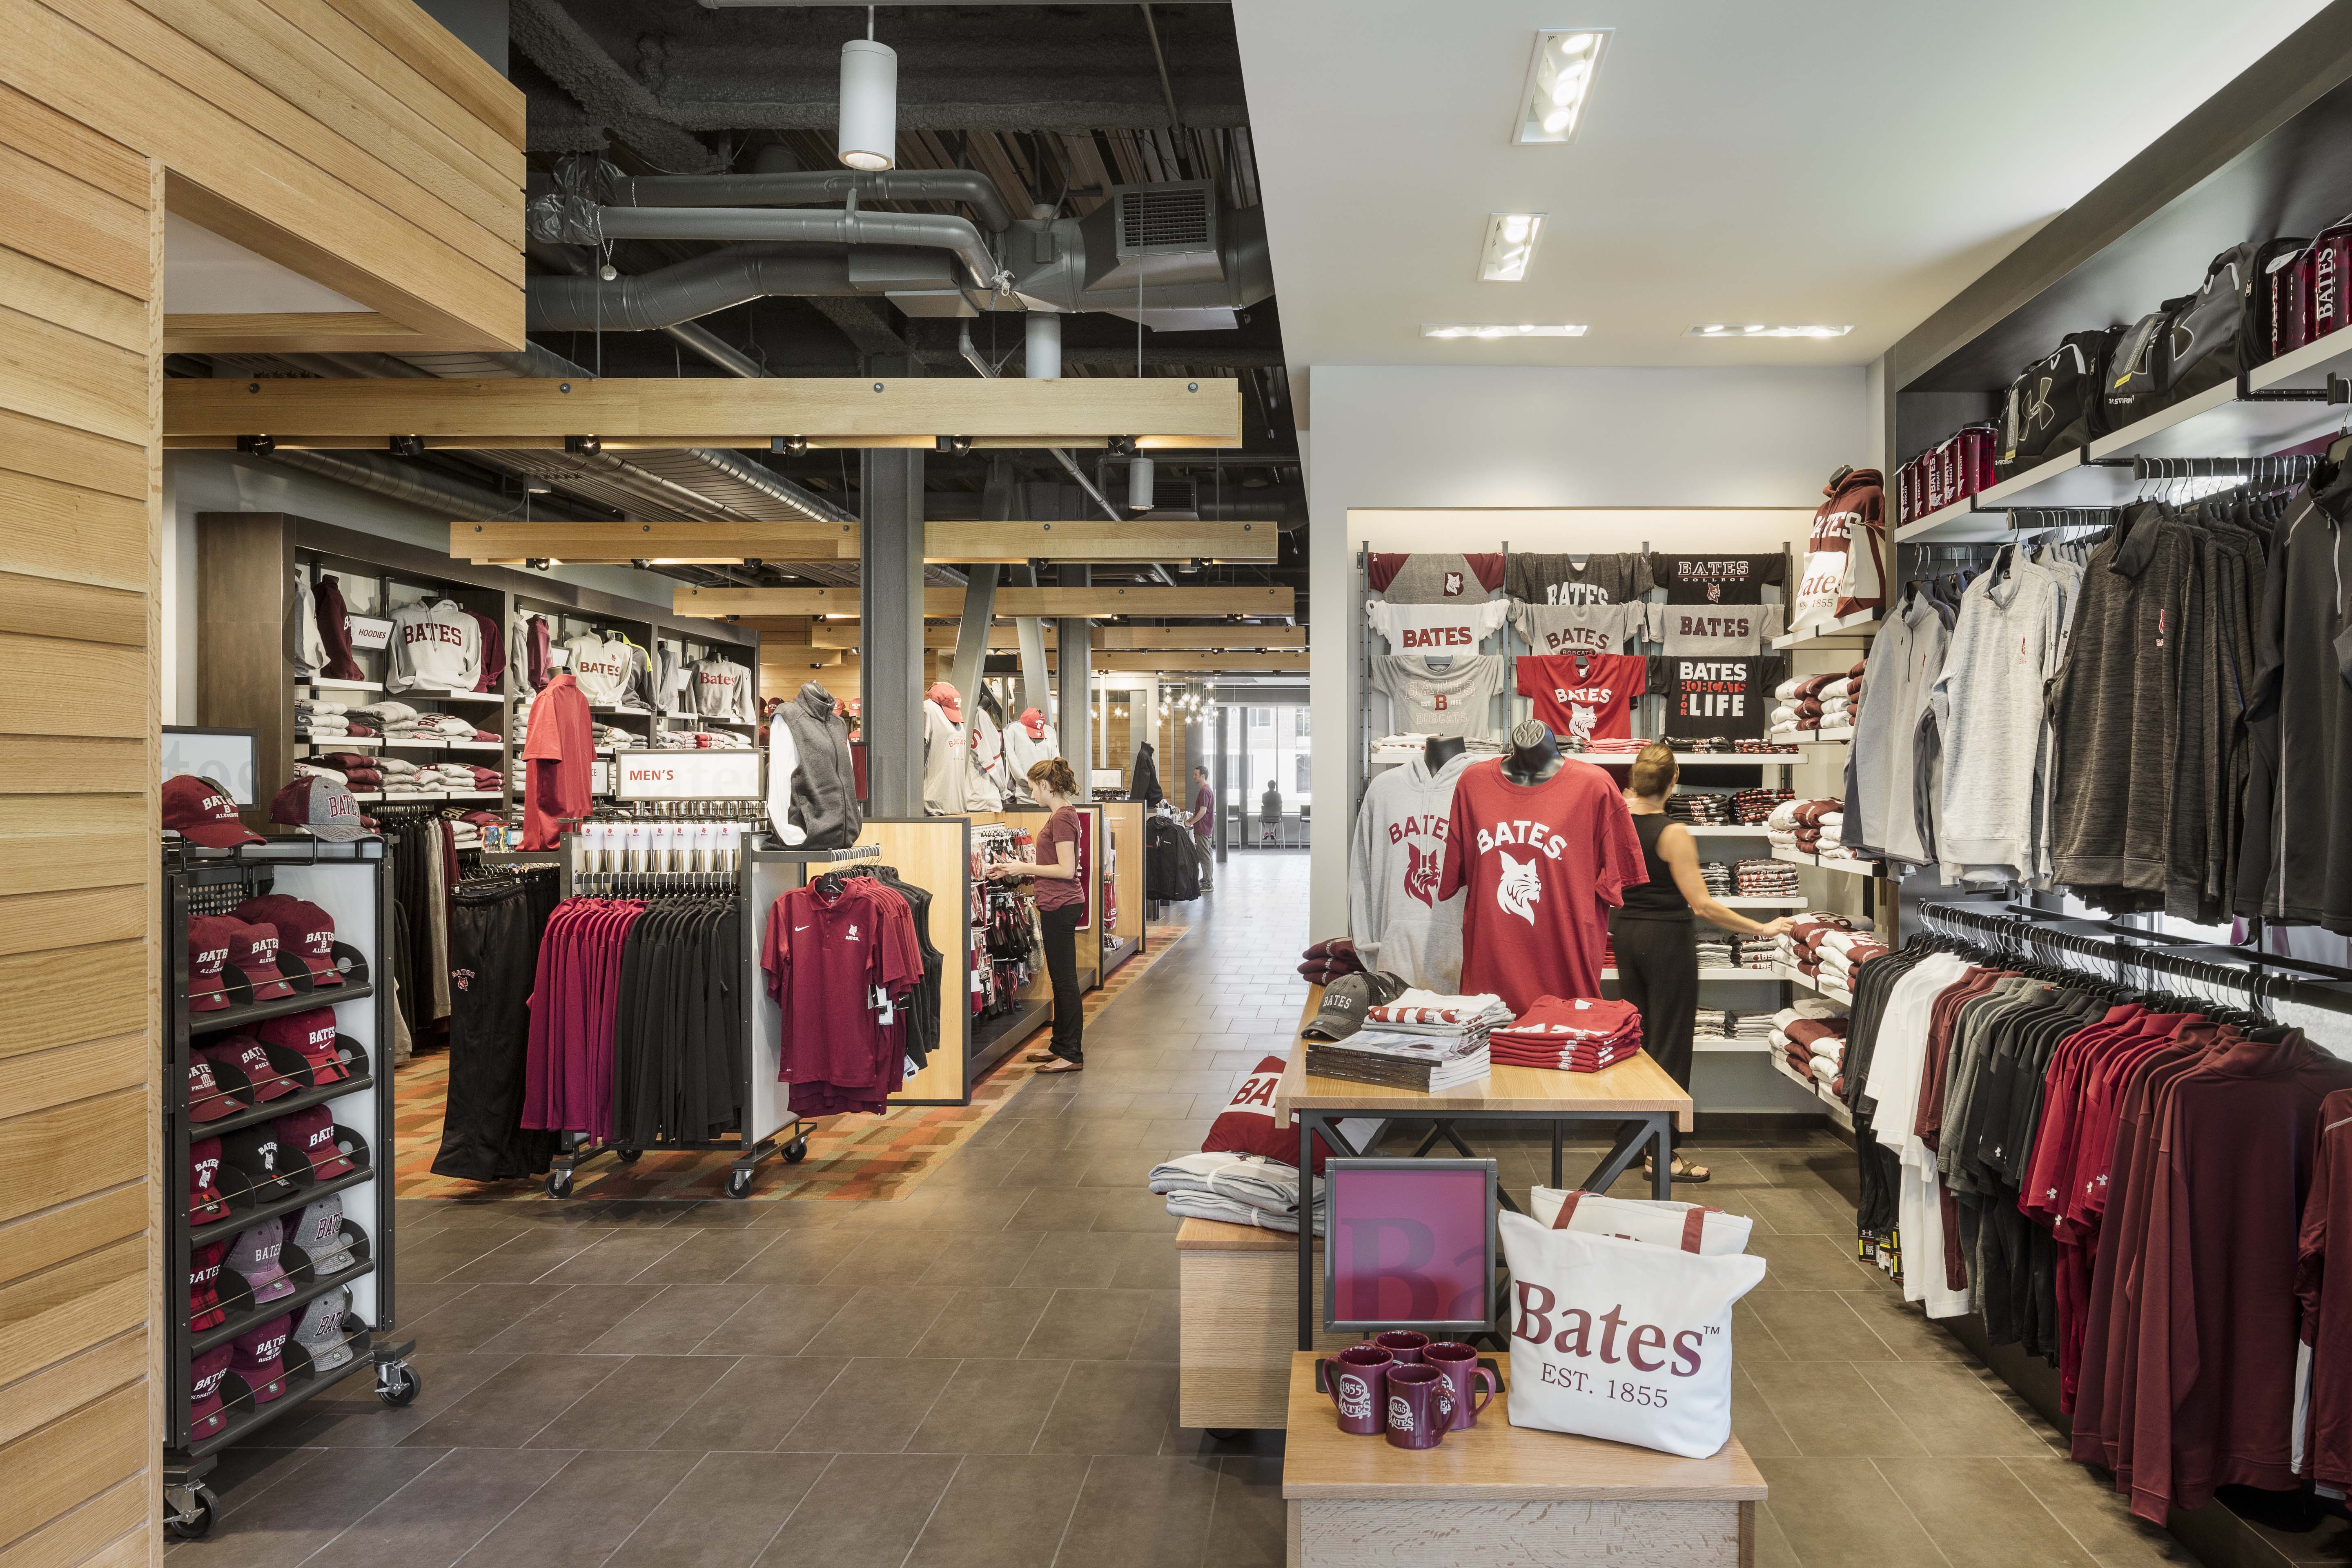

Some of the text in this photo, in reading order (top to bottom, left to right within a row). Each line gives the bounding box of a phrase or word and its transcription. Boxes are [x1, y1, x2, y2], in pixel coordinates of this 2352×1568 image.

[2319, 248, 2333, 321] BATES
[1678, 561, 1749, 576] BATES
[1547, 582, 1608, 605] BATES
[1812, 599, 1833, 608] 1855
[359, 629, 386, 639] HOODIES
[403, 623, 462, 646] BATES
[1680, 616, 1749, 637] BATES
[1402, 627, 1472, 648] BATES
[1546, 627, 1610, 650] BATES
[580, 662, 620, 677] BATES
[1680, 662, 1746, 681] BATES
[699, 672, 735, 686] Bates
[1681, 681, 1746, 693] BOBCATS
[1405, 679, 1476, 699] BATES
[1555, 688, 1612, 704] BATES
[1434, 695, 1447, 710] B
[1690, 694, 1744, 717] LIFE
[1416, 712, 1467, 724] BOBCATS
[948, 738, 966, 748] BOBCAT
[630, 770, 674, 781] MEN'S
[224, 805, 231, 813] B
[1389, 815, 1450, 845] BATE
[1477, 820, 1568, 859] BATES
[305, 932, 334, 943] BATES
[321, 940, 326, 948] B
[252, 938, 279, 954] BATES
[196, 949, 229, 963] BATE
[452, 969, 475, 978] BATES
[1323, 995, 1352, 1009] BATES
[310, 1026, 335, 1044] BATES
[189, 1063, 212, 1078] ATE
[309, 1126, 334, 1147] BATE
[258, 1142, 277, 1155] BATES
[194, 1159, 219, 1172] BATES
[314, 1211, 343, 1241] BATE
[256, 1243, 281, 1262] BATES
[313, 1309, 345, 1337] BAT
[1512, 1280, 1703, 1377] Bates
[256, 1334, 286, 1355] BATES
[194, 1368, 227, 1392] BATES
[1540, 1362, 1668, 1408] EST. 1855
[1342, 1381, 1362, 1396] 1855
[1339, 1393, 1371, 1414] BATES
[1392, 1402, 1406, 1413] 1855
[1389, 1411, 1414, 1427] BATES
